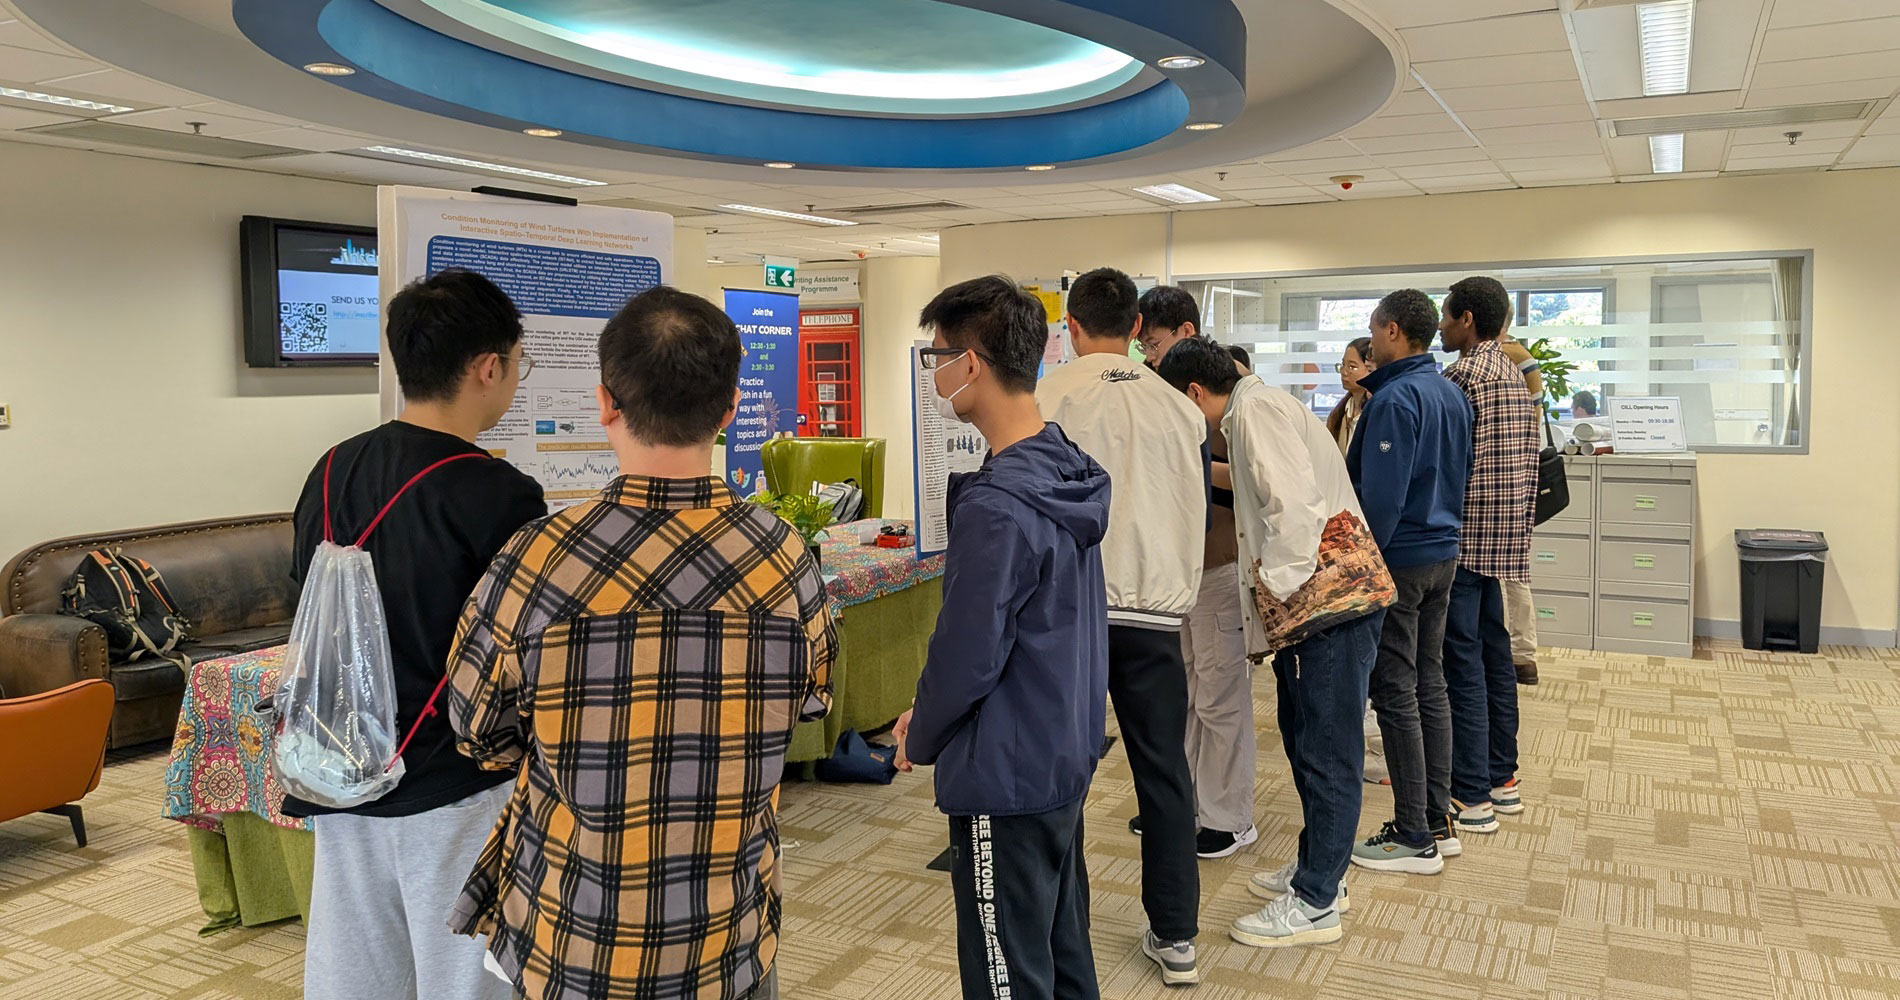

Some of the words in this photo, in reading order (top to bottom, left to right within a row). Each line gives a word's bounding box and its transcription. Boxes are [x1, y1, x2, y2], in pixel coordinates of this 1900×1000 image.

[442, 214, 478, 223] Condition
[480, 217, 518, 228] Monitoring
[528, 222, 546, 231] Wind
[548, 224, 575, 234] Turbines
[593, 230, 640, 242] Implementation
[460, 224, 498, 234] Interactive
[558, 235, 574, 244] Deep
[576, 238, 602, 248] Learning
[804, 314, 851, 324] TELEPHONE
[758, 325, 792, 336] CORNER
[1101, 368, 1141, 382] Matcha
[740, 377, 764, 386] Practice
[763, 390, 772, 398] fun
[739, 406, 750, 414] way
[752, 403, 764, 412] with
[736, 417, 767, 426] interesting
[737, 430, 754, 440] topics
[980, 841, 994, 900] BEYOND
[984, 903, 996, 933] ONE
[990, 933, 1009, 984] EGREE
